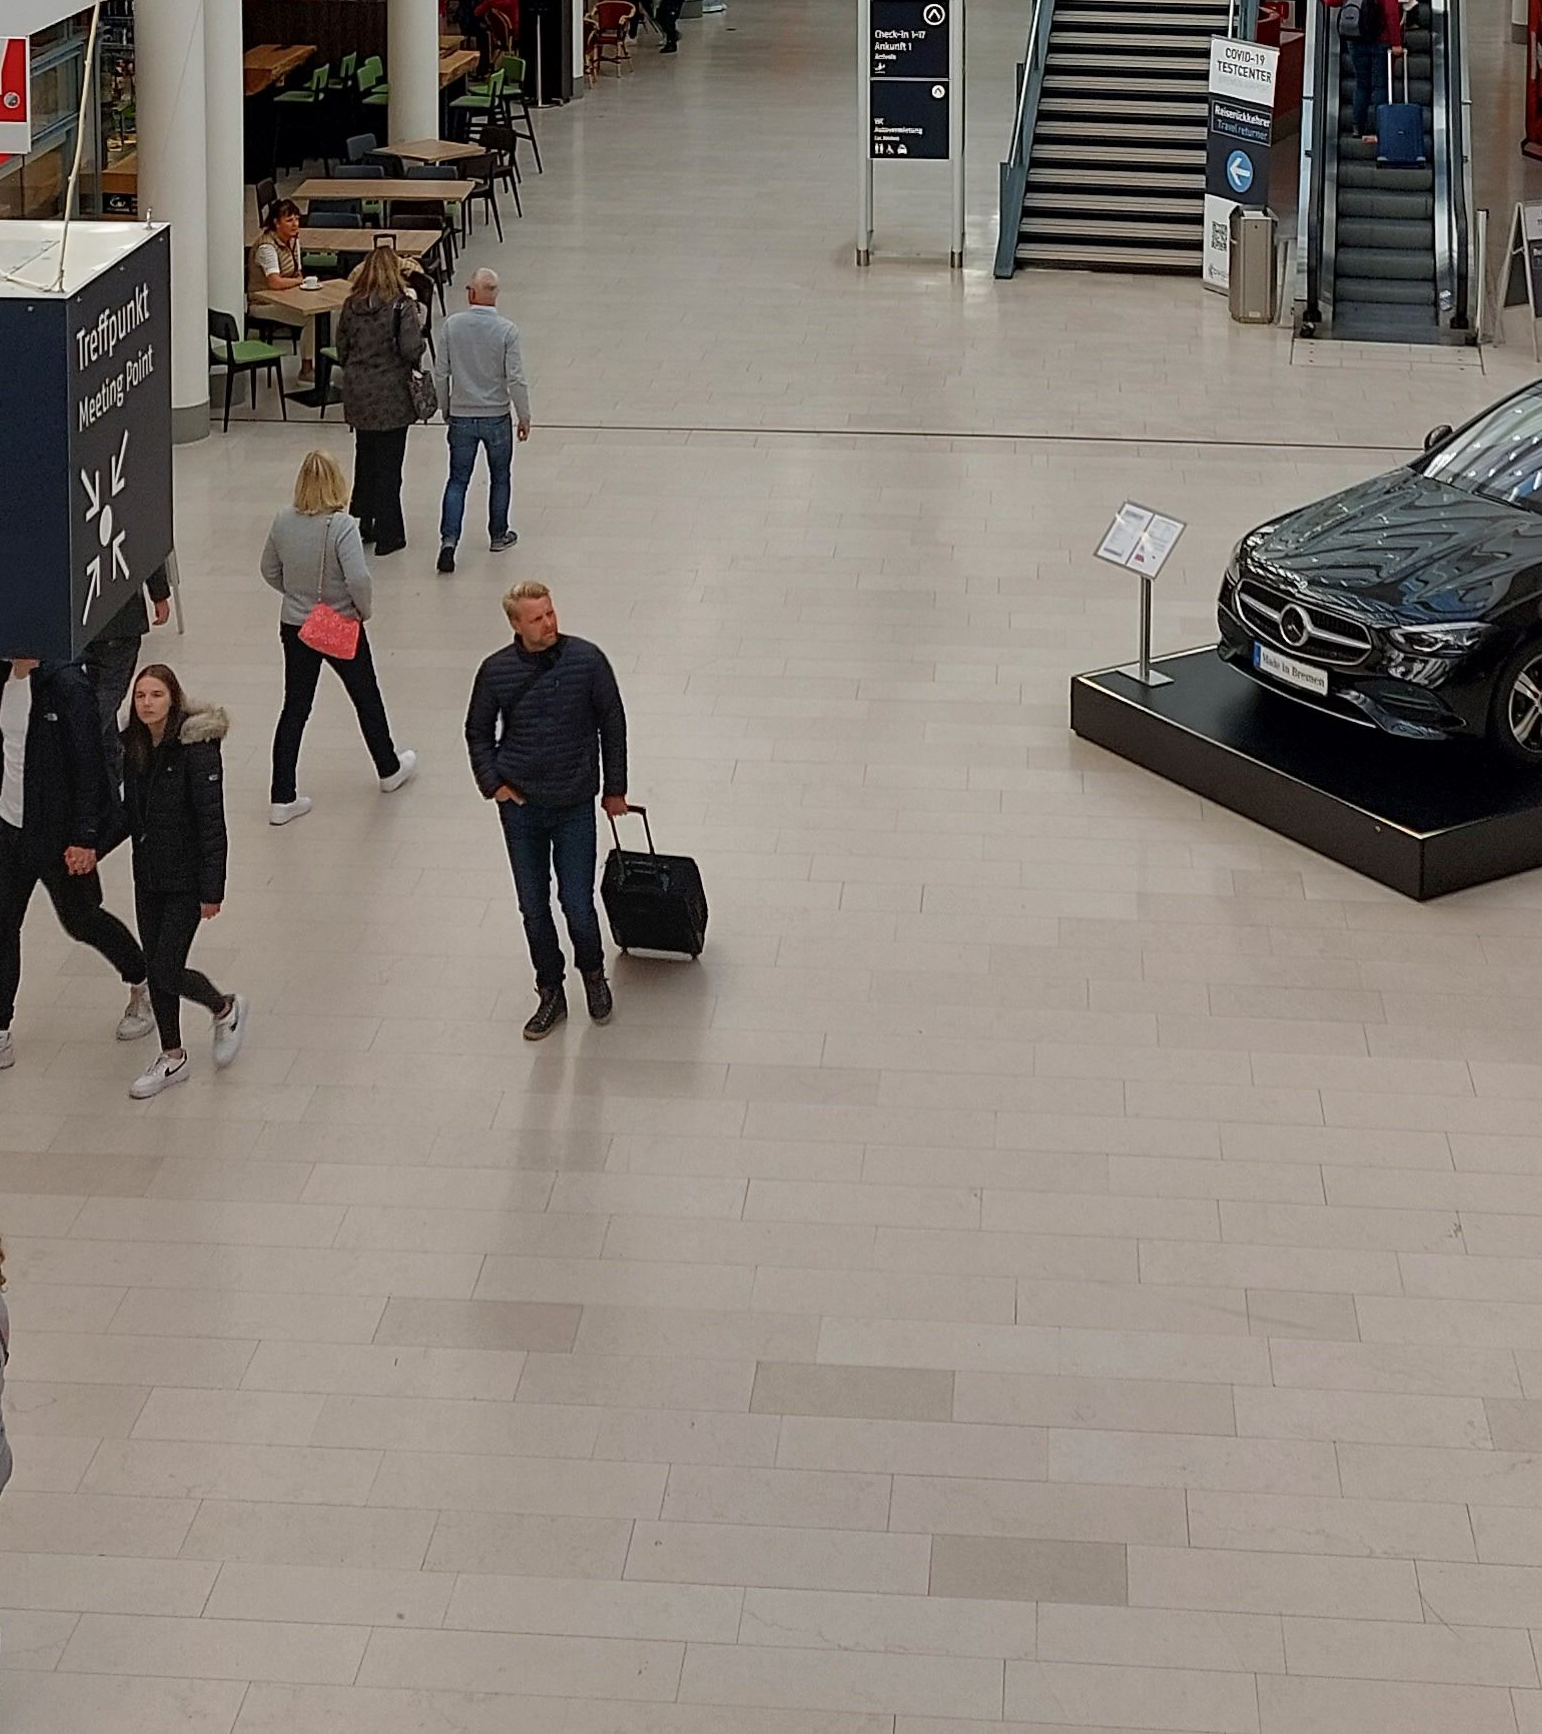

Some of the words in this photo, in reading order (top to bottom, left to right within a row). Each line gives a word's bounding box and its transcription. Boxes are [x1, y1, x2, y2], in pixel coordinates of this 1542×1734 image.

[874, 30, 909, 39] Check-in
[874, 42, 906, 51] Ankunft
[1225, 47, 1265, 65] COVID-19
[1217, 60, 1272, 83] TESTCENTER
[75, 282, 150, 371] Treffpunkt
[77, 372, 124, 433] Meeting
[126, 345, 155, 397] Point
[1292, 666, 1325, 688] Bremen
